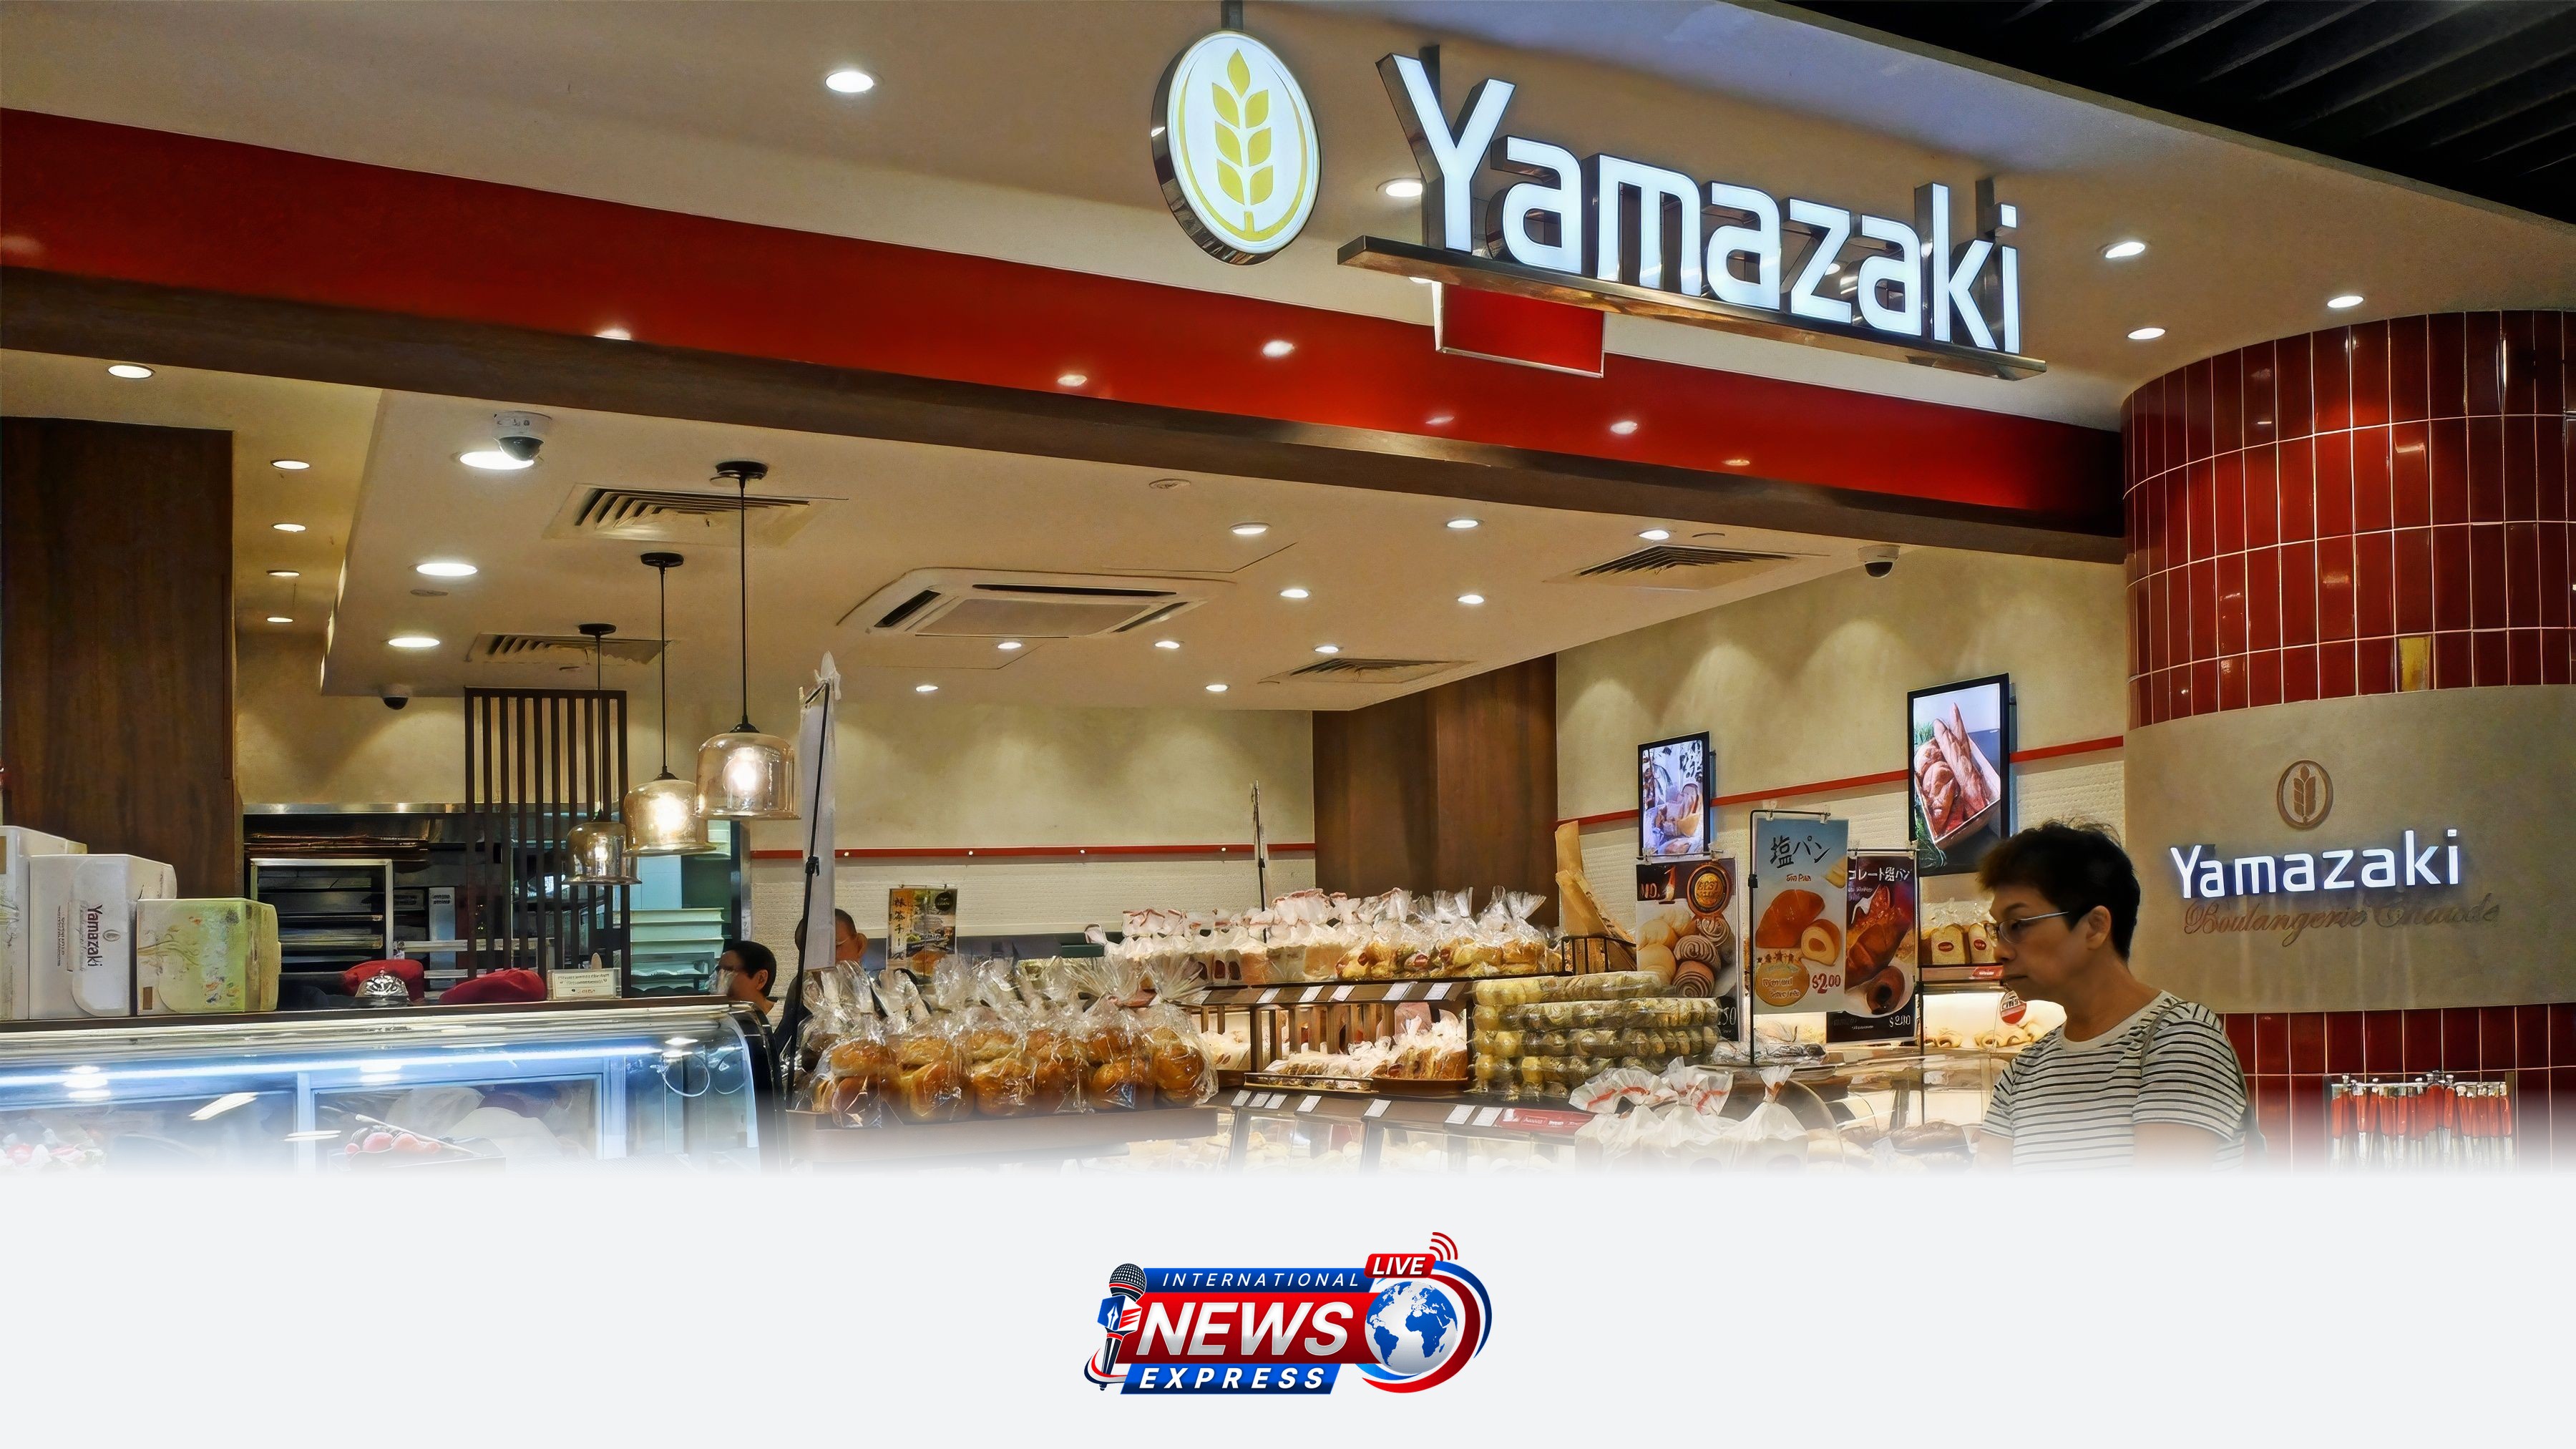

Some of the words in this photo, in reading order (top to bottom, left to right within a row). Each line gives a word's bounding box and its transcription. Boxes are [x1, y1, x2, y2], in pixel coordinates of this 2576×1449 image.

[1377, 52, 2022, 355] Yamazaki
[1770, 835, 1831, 869] 塩パン
[2170, 828, 2461, 899] Yamazaki
[87, 904, 103, 967] Yamazaki
[2184, 898, 2368, 947] Boulangerie
